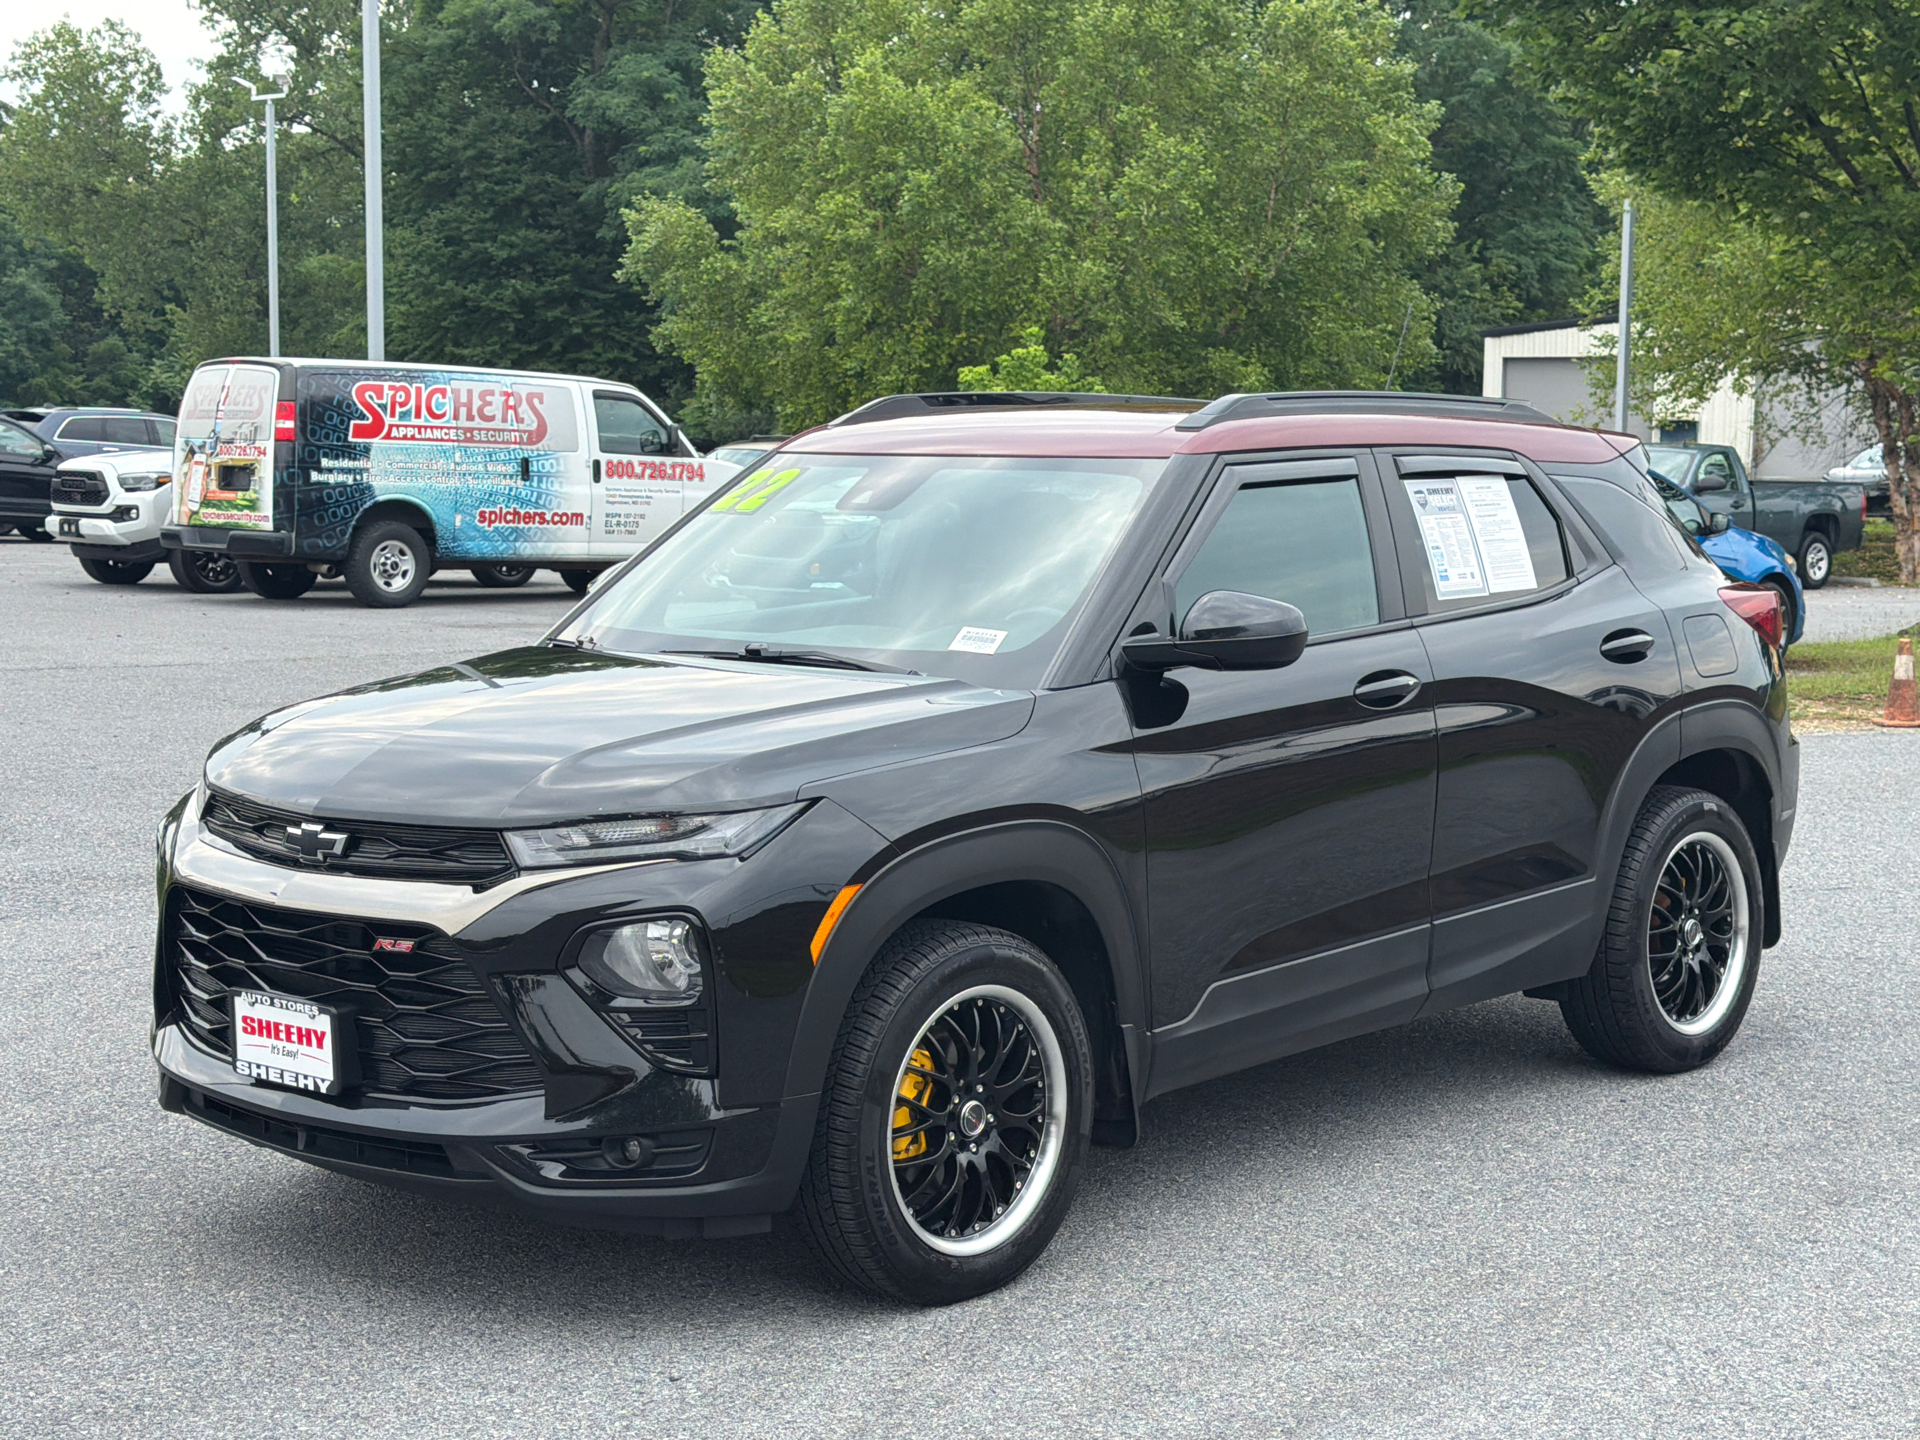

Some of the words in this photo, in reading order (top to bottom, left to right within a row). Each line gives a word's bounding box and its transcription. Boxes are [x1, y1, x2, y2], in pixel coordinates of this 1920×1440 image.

[350, 382, 548, 446] SPICHERS
[391, 427, 465, 440] APPLIANCES
[473, 431, 529, 443] SECURITY
[321, 458, 376, 469] Residential
[385, 460, 440, 470] Commercial
[605, 459, 706, 482] 800.726.1794
[311, 471, 353, 485] Burglary
[363, 473, 382, 482] Fire
[388, 474, 422, 483] Access
[425, 475, 458, 484] Control
[710, 467, 801, 513] 22
[1426, 487, 1454, 496] SHEEHY
[477, 506, 585, 527] spichers.com
[604, 520, 640, 528] EL-R-0175
[374, 938, 415, 953] RS
[239, 991, 271, 1008] AUTO
[273, 998, 320, 1016] STORES
[241, 1014, 327, 1050] SHEEHY
[270, 1043, 281, 1056] It's
[281, 1046, 299, 1060] Easy!
[235, 1060, 334, 1094] SHEEHY
[864, 1149, 900, 1247] GENERAL
